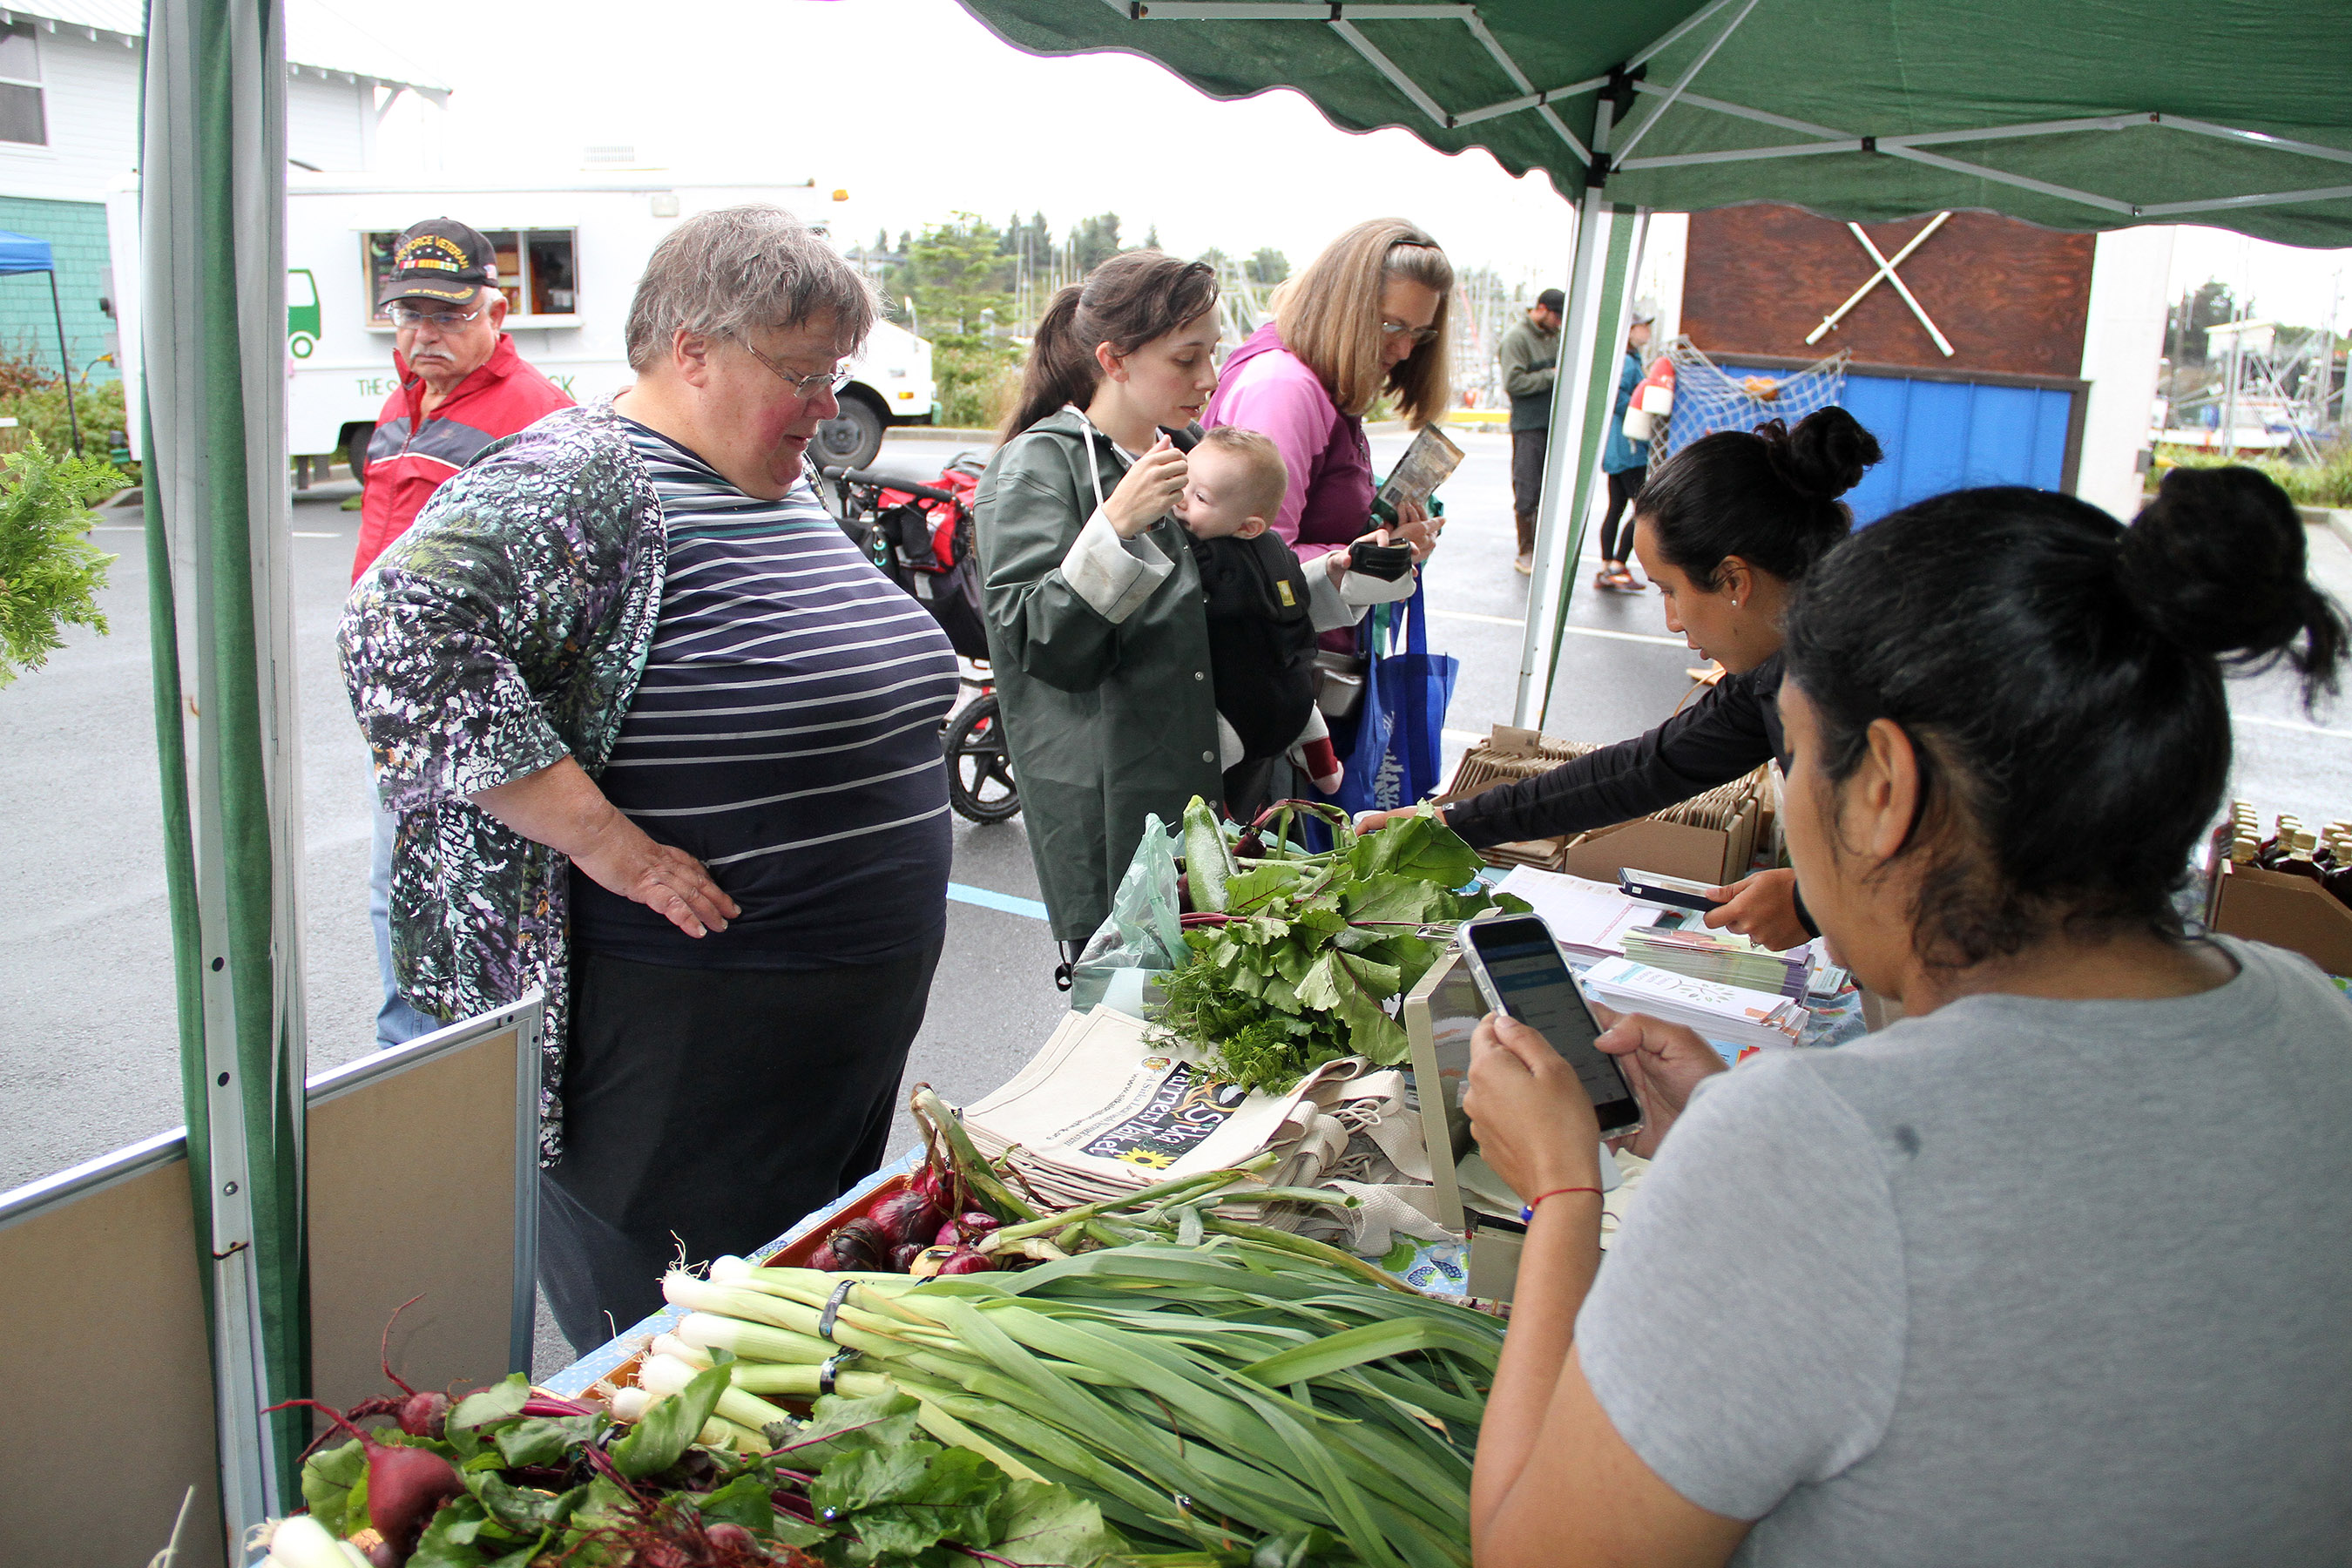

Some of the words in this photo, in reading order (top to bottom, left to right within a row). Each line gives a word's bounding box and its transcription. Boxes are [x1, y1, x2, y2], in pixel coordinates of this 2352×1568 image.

[394, 247, 407, 264] AIR
[405, 234, 435, 252] FORCE
[435, 235, 470, 269] VETERAN
[356, 379, 384, 397] THE
[1132, 1083, 1152, 1103] Sitka
[1088, 1119, 1165, 1155] Market
[1152, 1102, 1224, 1144] Sitka
